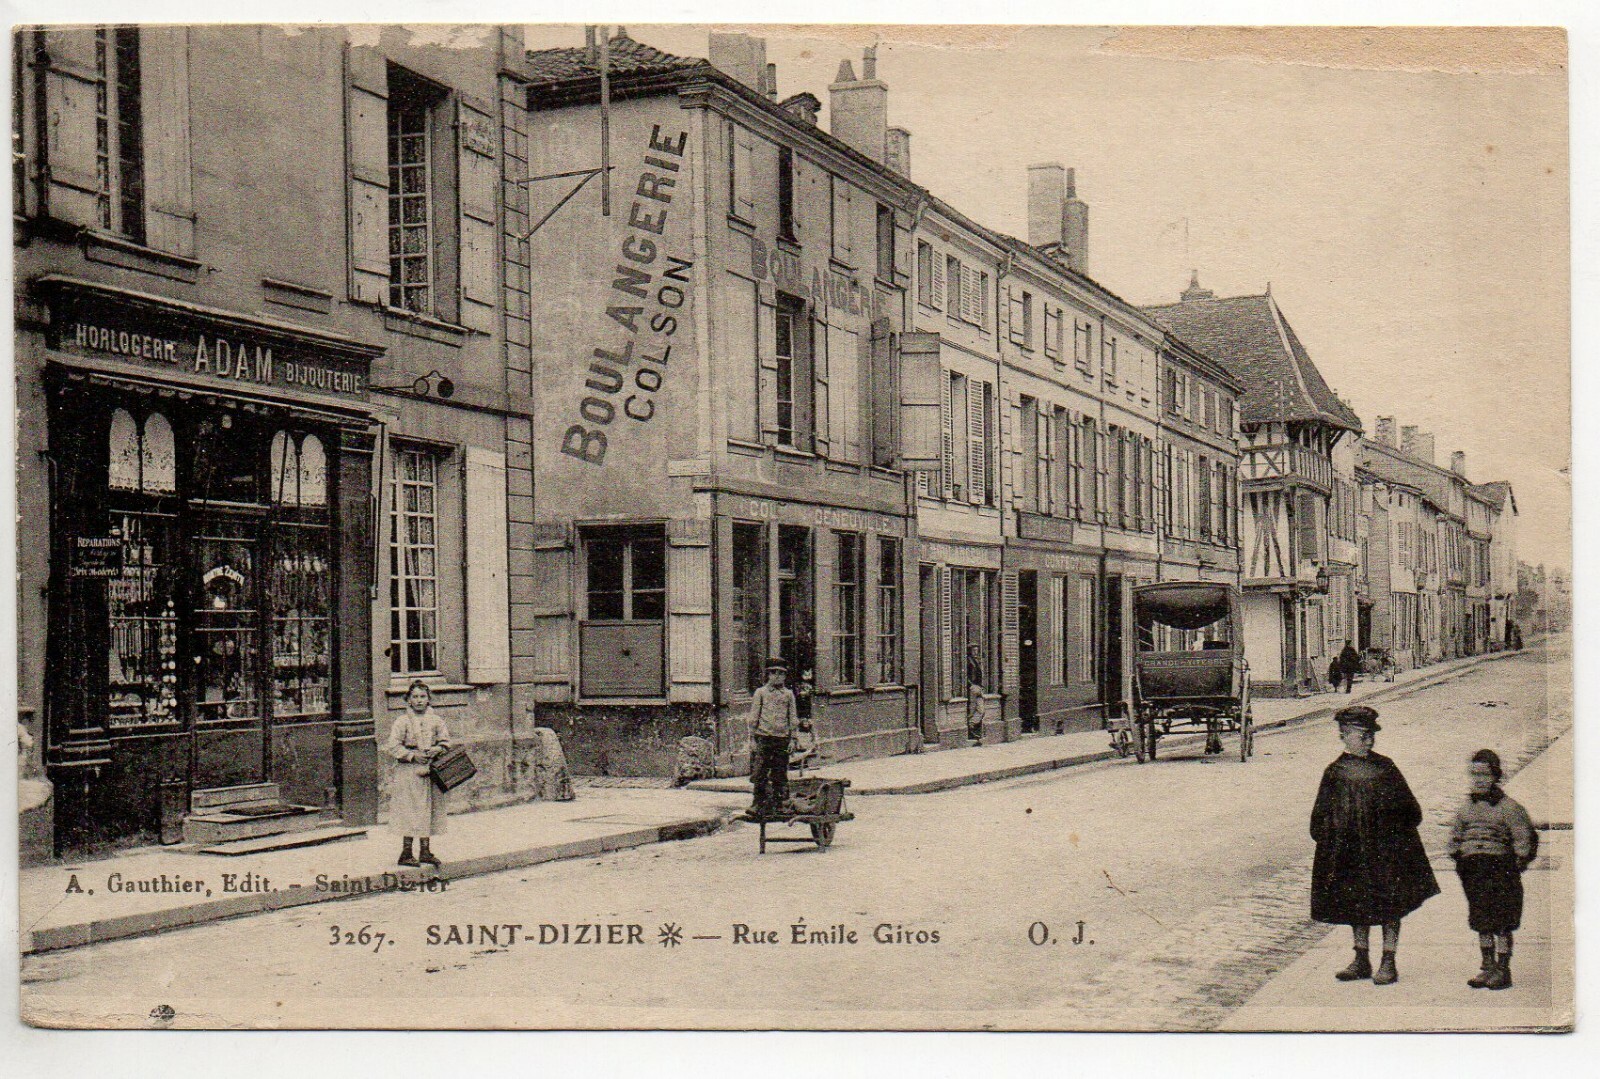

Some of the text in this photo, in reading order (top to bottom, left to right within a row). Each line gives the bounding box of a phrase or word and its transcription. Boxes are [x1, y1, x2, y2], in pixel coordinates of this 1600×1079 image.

[561, 124, 688, 467] BOULANGERIE
[75, 324, 178, 363] HORLOGERIE
[194, 334, 274, 386] ADAM
[624, 256, 694, 423] COLSON
[285, 361, 363, 395] BIJOUTERIE
